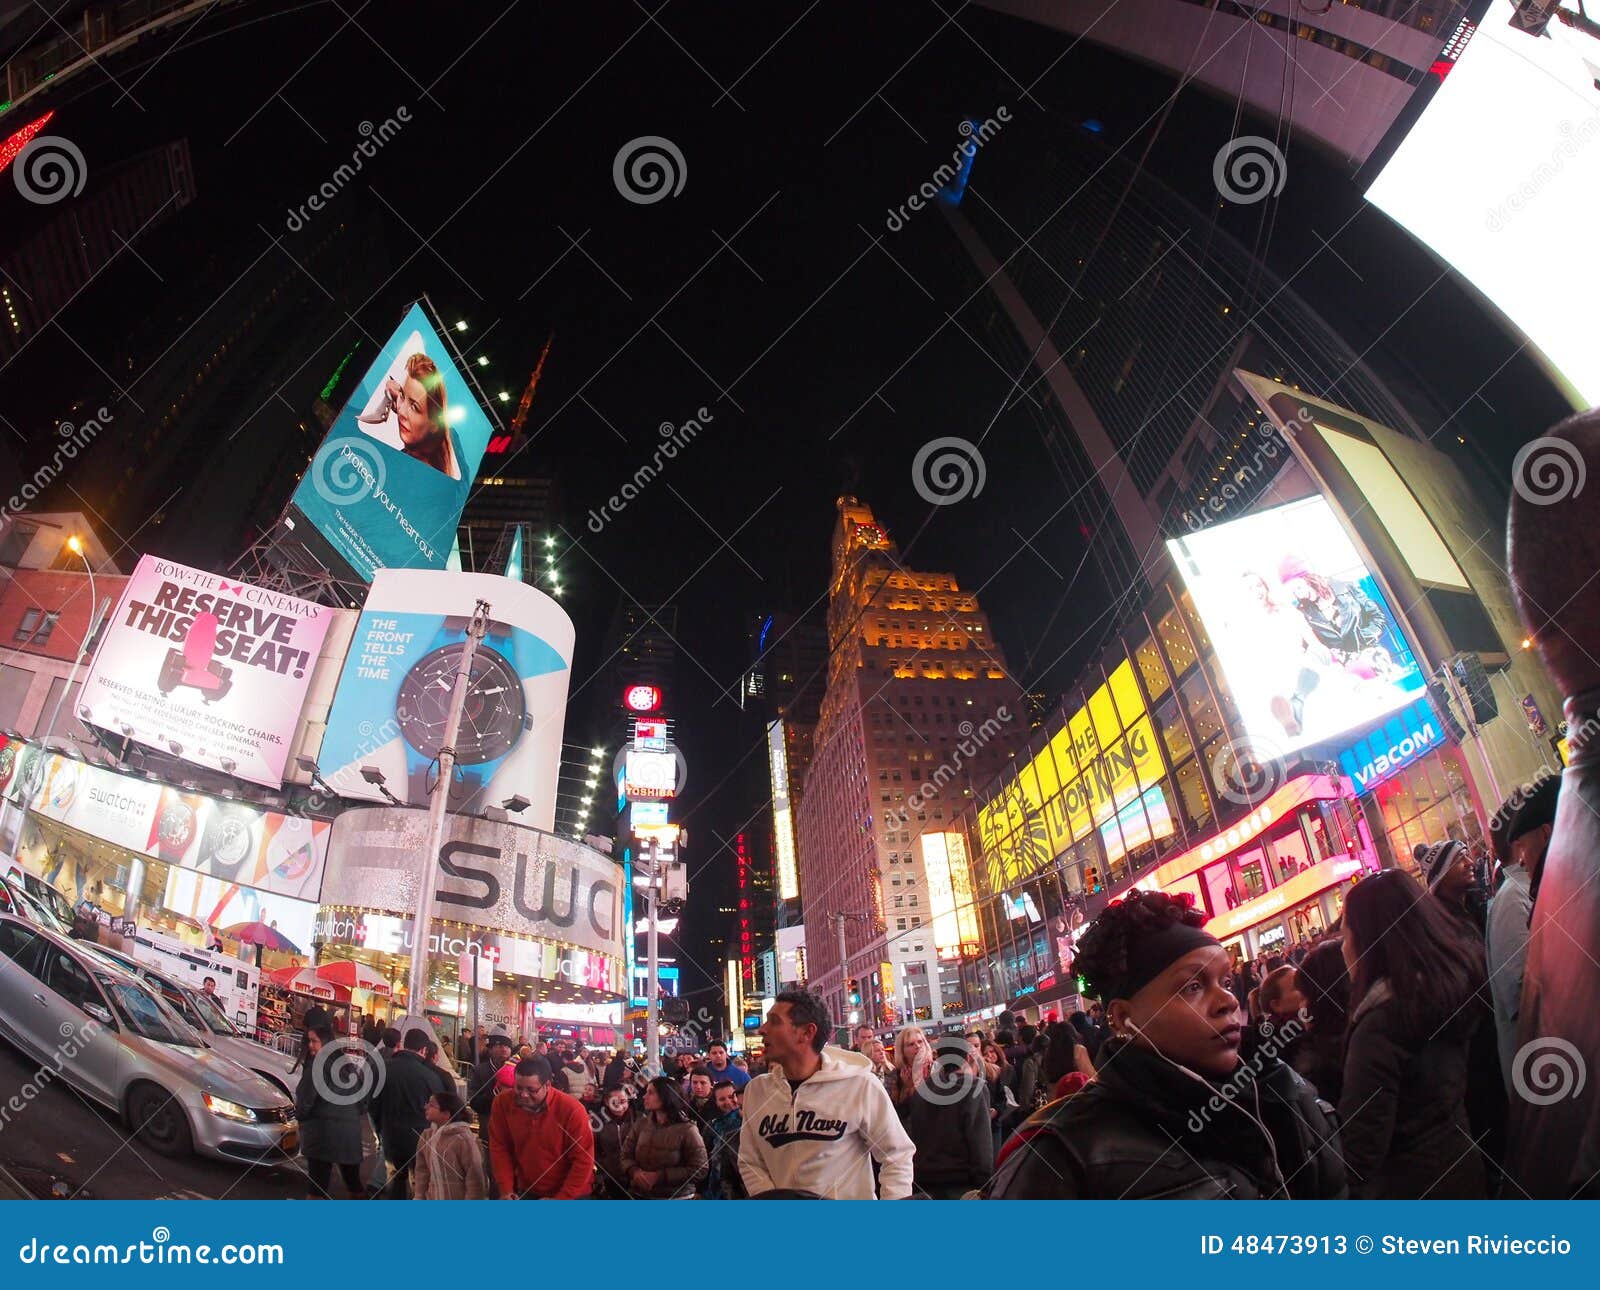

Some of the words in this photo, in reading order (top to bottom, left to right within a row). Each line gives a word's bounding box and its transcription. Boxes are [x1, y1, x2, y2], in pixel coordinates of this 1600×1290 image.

[1441, 16, 1470, 57] MARRIOTT
[341, 444, 376, 489] protect
[373, 488, 398, 513] your
[395, 510, 420, 541] heart
[419, 540, 434, 562] out
[154, 581, 297, 644] RESERVE
[246, 589, 320, 619] CINEMAS
[124, 599, 191, 642] THIS
[213, 628, 310, 680] SEAT!
[367, 631, 414, 644] FRONT
[371, 618, 397, 631] THE
[360, 654, 387, 667] THE
[364, 642, 405, 656] TELLS
[357, 666, 390, 680] TIME
[99, 675, 133, 695] RESERVED
[170, 704, 202, 721] LUXURY
[204, 713, 246, 735] ROCKING
[247, 727, 283, 746] CHAIRS.
[1065, 726, 1097, 766] THE
[89, 787, 136, 811] swatch
[626, 786, 674, 797] TOSHIBA
[1048, 773, 1095, 839] LION
[1090, 728, 1150, 805] KING
[737, 834, 747, 888] ERNST
[315, 917, 355, 939] swatch
[1258, 926, 1284, 947] AERO
[741, 919, 753, 979] YOUNG
[758, 1110, 789, 1137] Old
[798, 1109, 847, 1141] Navy
